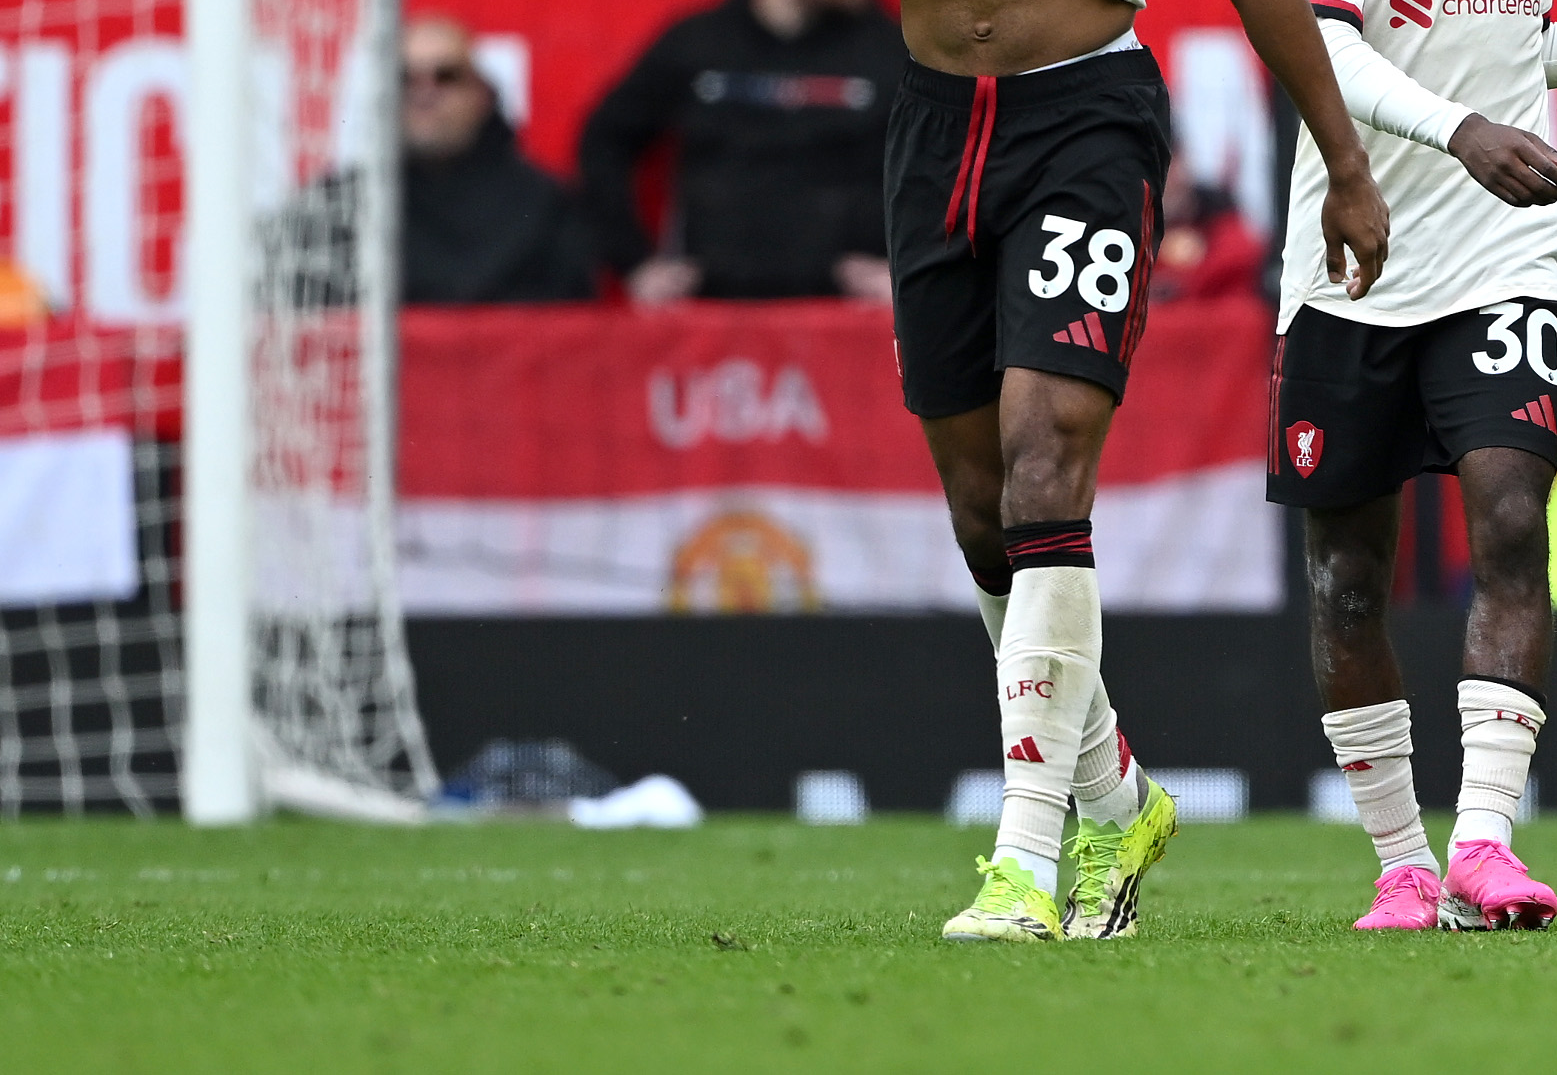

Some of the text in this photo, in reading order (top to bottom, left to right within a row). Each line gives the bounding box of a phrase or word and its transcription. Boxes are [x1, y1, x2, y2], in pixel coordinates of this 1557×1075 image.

[1028, 214, 1135, 313] 38
[646, 358, 830, 453] USA
[1006, 679, 1054, 701] LFC
